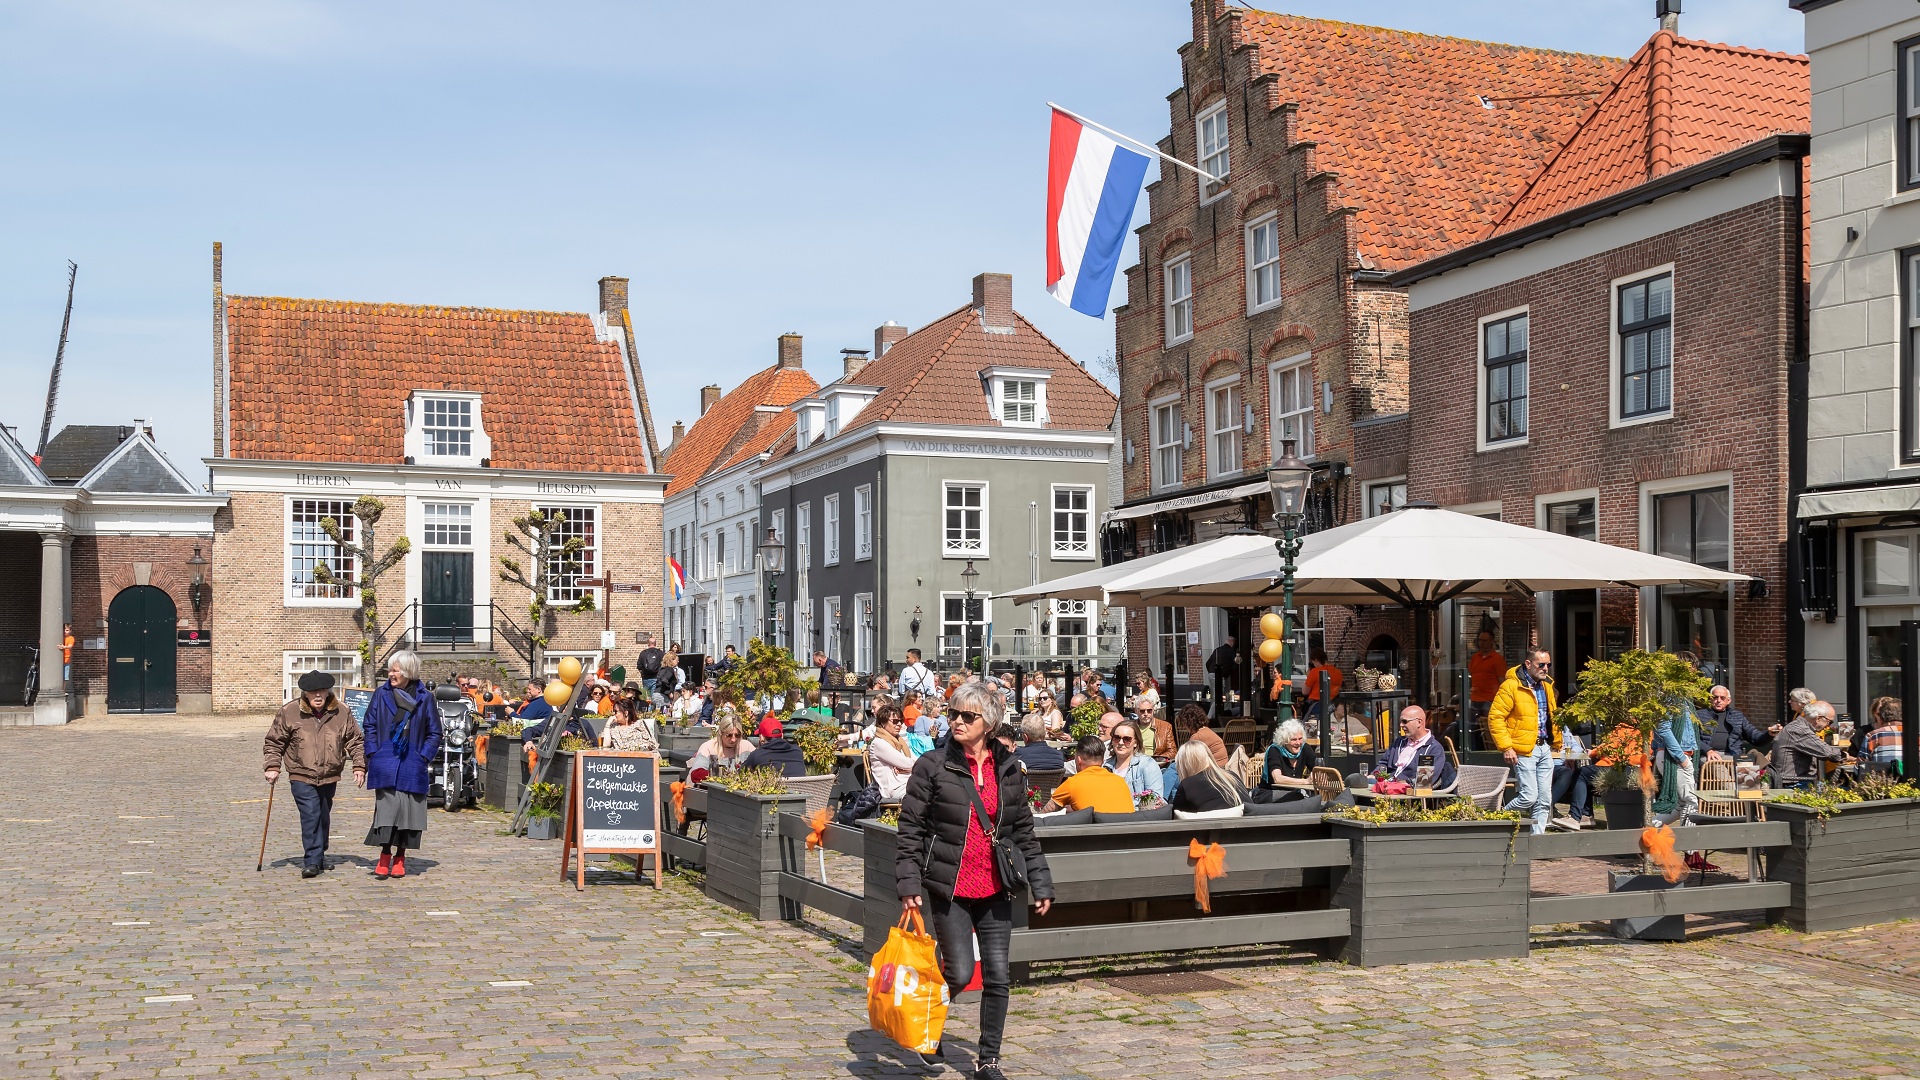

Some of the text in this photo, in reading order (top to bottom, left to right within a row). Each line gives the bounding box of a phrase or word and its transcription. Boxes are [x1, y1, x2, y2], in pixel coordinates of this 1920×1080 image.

[904, 441, 1094, 458] VAN DIJK RESTAURANT & KOOKSTUDIO
[296, 473, 597, 495] HEEREN VAN HEUSDEN
